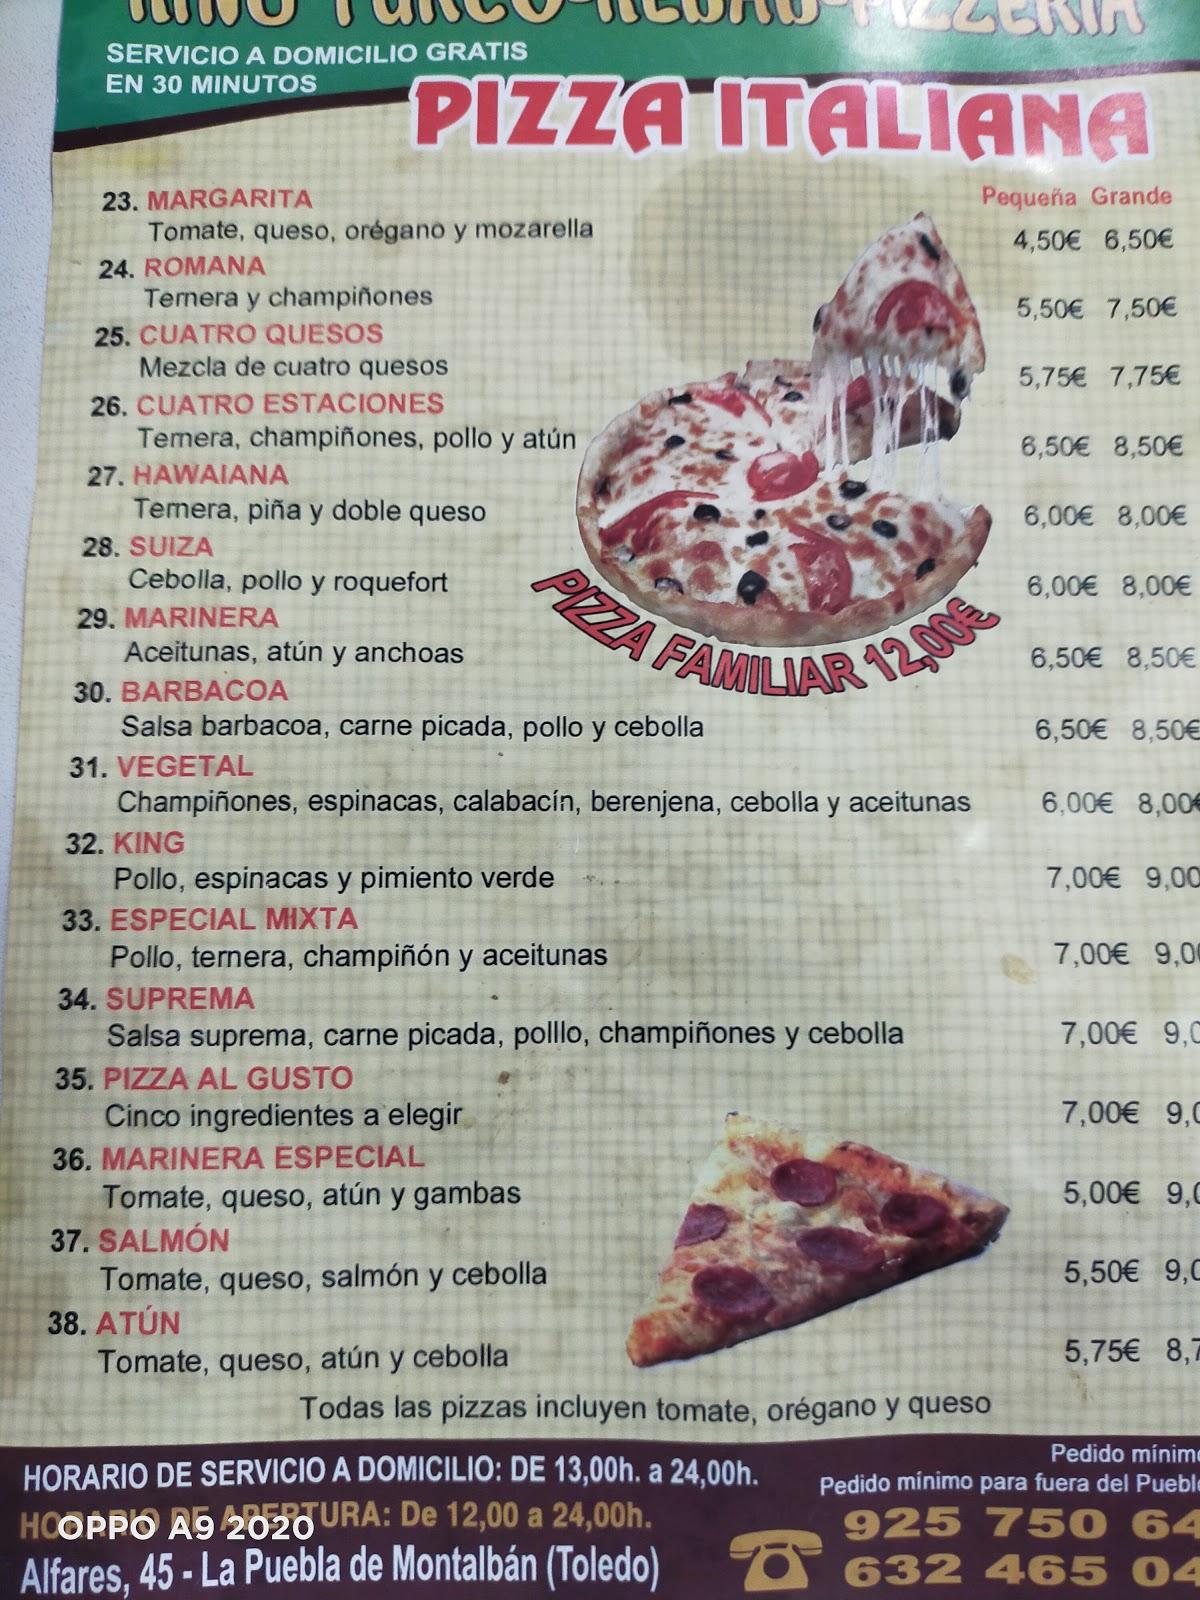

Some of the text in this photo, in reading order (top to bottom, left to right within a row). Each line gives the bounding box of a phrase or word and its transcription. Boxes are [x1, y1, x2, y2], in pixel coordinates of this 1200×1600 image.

[106, 42, 528, 66] SERVICIO DOMICILIO GRATIS
[106, 74, 317, 94] EN 30 MINUTOS
[415, 80, 1150, 164] PIZZA ITALIANA
[102, 188, 313, 212] 23. MARGARITA
[981, 186, 1173, 212] Pequeña Grande
[149, 219, 594, 247] Tomate, queso, orégano mozarella
[1013, 229, 1174, 254] 4,50€ 6,50€
[144, 256, 266, 278] ROMANA
[144, 286, 433, 312] Ternera champiñones
[1016, 297, 1178, 323] 5,50€ 7,50€
[94, 323, 384, 347] 25. CUATRO QUESOS
[139, 355, 449, 382] Mezcla cuatro quesos
[1019, 365, 1182, 391] 5,75€ 7,75€
[137, 393, 445, 416] CUATRO ESTACIONES
[138, 425, 577, 453] Ternera, champiñones, pollo atún
[1113, 435, 1184, 460] 8,50€
[87, 464, 289, 487] 27. HAWAIANA
[134, 499, 487, 527] Ternera, piña doble queso
[1024, 504, 1188, 530] 6,00€ 8,00€
[128, 536, 214, 558] SUIZA
[128, 569, 449, 597] Cebolla, roquefort
[1027, 575, 1099, 600] 6,00€
[77, 607, 280, 629] 29. MARINERA
[531, 569, 1002, 697] PIZZA FAMILIAR 12,00€
[124, 641, 464, 667] Aceitunas, atún anchoas
[1031, 646, 1197, 672] 6,50€ 8,50€
[121, 679, 289, 702] BARBACOA
[121, 715, 705, 742] Salsa barbacoa, carne picada, pollo cebolla
[1035, 718, 1109, 744] 6,50€
[69, 755, 254, 778] 31. VEGETAL
[117, 789, 971, 818] Champiñones, espinacas, calabacín, berenjena, cebolla aceitunas
[1041, 791, 1115, 817] 6,00€
[65, 832, 186, 855] 32. KING
[114, 866, 555, 894] Pollo, espinacas pimiento verde
[1047, 866, 1122, 893] 7,00€
[61, 907, 359, 932] 33. ESPECIAL MIXTA
[191, 942, 608, 971] ternera, champiñón aceitunas
[106, 987, 255, 1011] SUPREMA
[107, 1025, 182, 1048] Salsa
[190, 1029, 315, 1053] suprema,
[407, 1023, 504, 1051] picada,
[599, 1022, 777, 1050] champiñones
[1061, 1021, 1139, 1049] 7,00€
[55, 1066, 354, 1091] 35. PIZZA GUSTO
[105, 1103, 464, 1132] Cinco ingredientes elegir
[102, 1145, 426, 1171] MARINERA ESPECIAL
[103, 1181, 522, 1213] Tomate, queso, atún gambas
[1063, 1181, 1141, 1209] 5,00€
[50, 1222, 230, 1254] 37. SALMÓN
[321, 1262, 547, 1289] salmón cebolla
[1064, 1260, 1140, 1287] 5,50€
[47, 1305, 181, 1337] 38. ATÚN
[321, 1347, 380, 1371] atún
[1064, 1338, 1141, 1366] 5,75€
[300, 1395, 877, 1426] Todas pizzas incluyen tomate, orégano
[1051, 1443, 1125, 1464] Pedido
[24, 1454, 759, 1493] HORARIO SERVICIO DOMICILIO: 13,00h. 24,00h.
[820, 1471, 1090, 1496] Pedido mínimo para fuera
[400, 1500, 653, 1533] De 12,00 24,00h.
[843, 1505, 1108, 1542] 925 750
[20, 1544, 661, 1600] Alfares, 45 Puebla Montalbán (Toledo)
[843, 1552, 1108, 1589] 632 465
